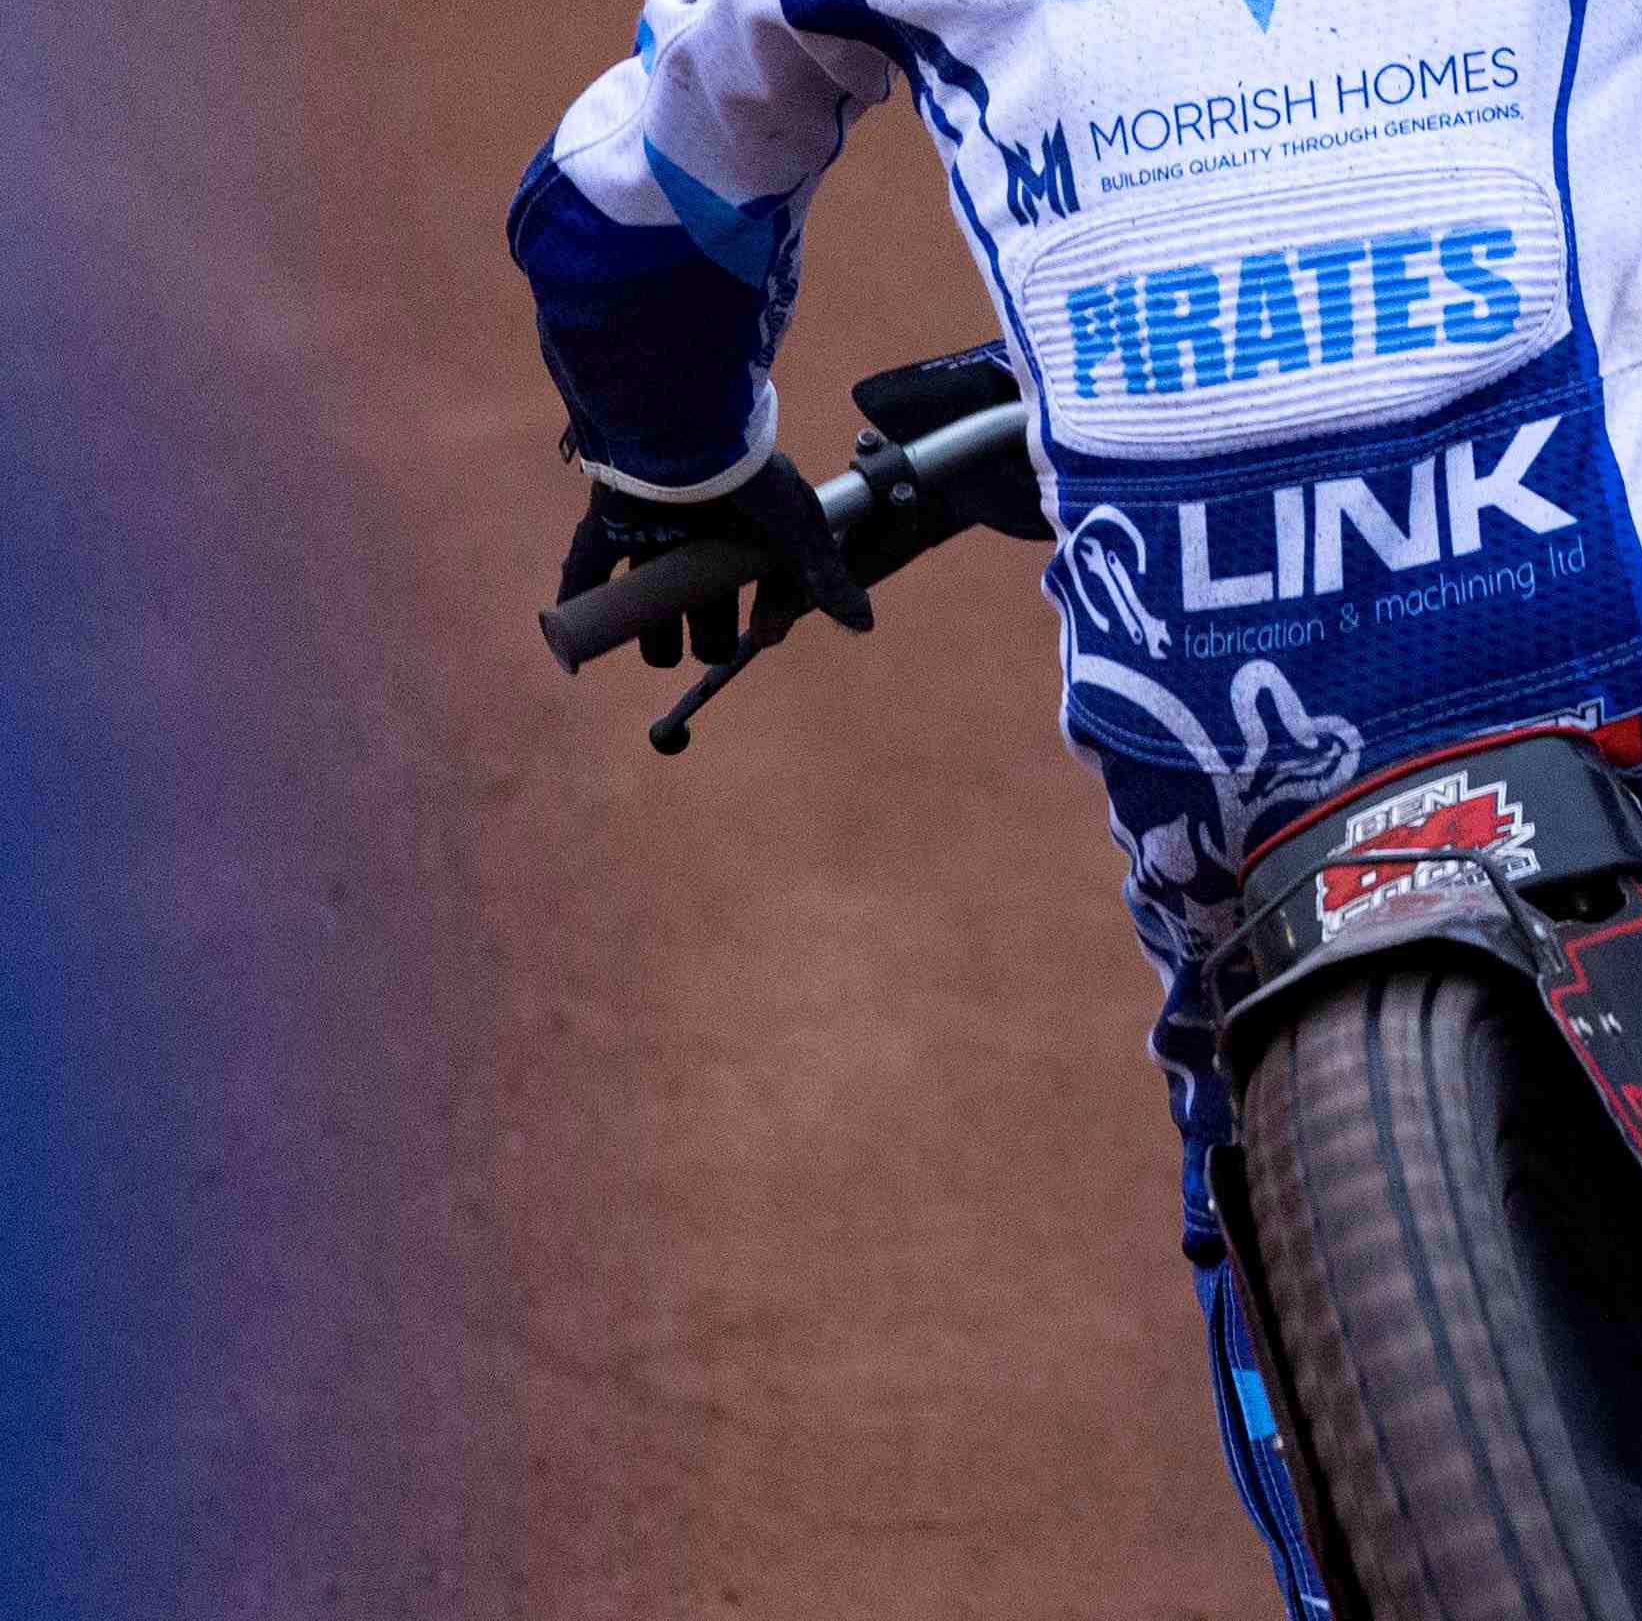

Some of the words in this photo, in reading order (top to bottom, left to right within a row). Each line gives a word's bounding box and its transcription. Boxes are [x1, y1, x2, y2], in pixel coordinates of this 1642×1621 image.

[1088, 78, 1318, 162] MORRISH
[1336, 46, 1519, 114] HOMES
[1101, 164, 1184, 193] BUILDING
[1188, 146, 1272, 176] QUALITY
[1279, 126, 1378, 159] THROUGH
[1065, 219, 1522, 400] PIRATES
[1177, 414, 1579, 614] LINK
[1183, 617, 1326, 660] fabrication
[1338, 601, 1361, 634] &
[1375, 559, 1536, 624] machining
[1547, 534, 1587, 579] ltd
